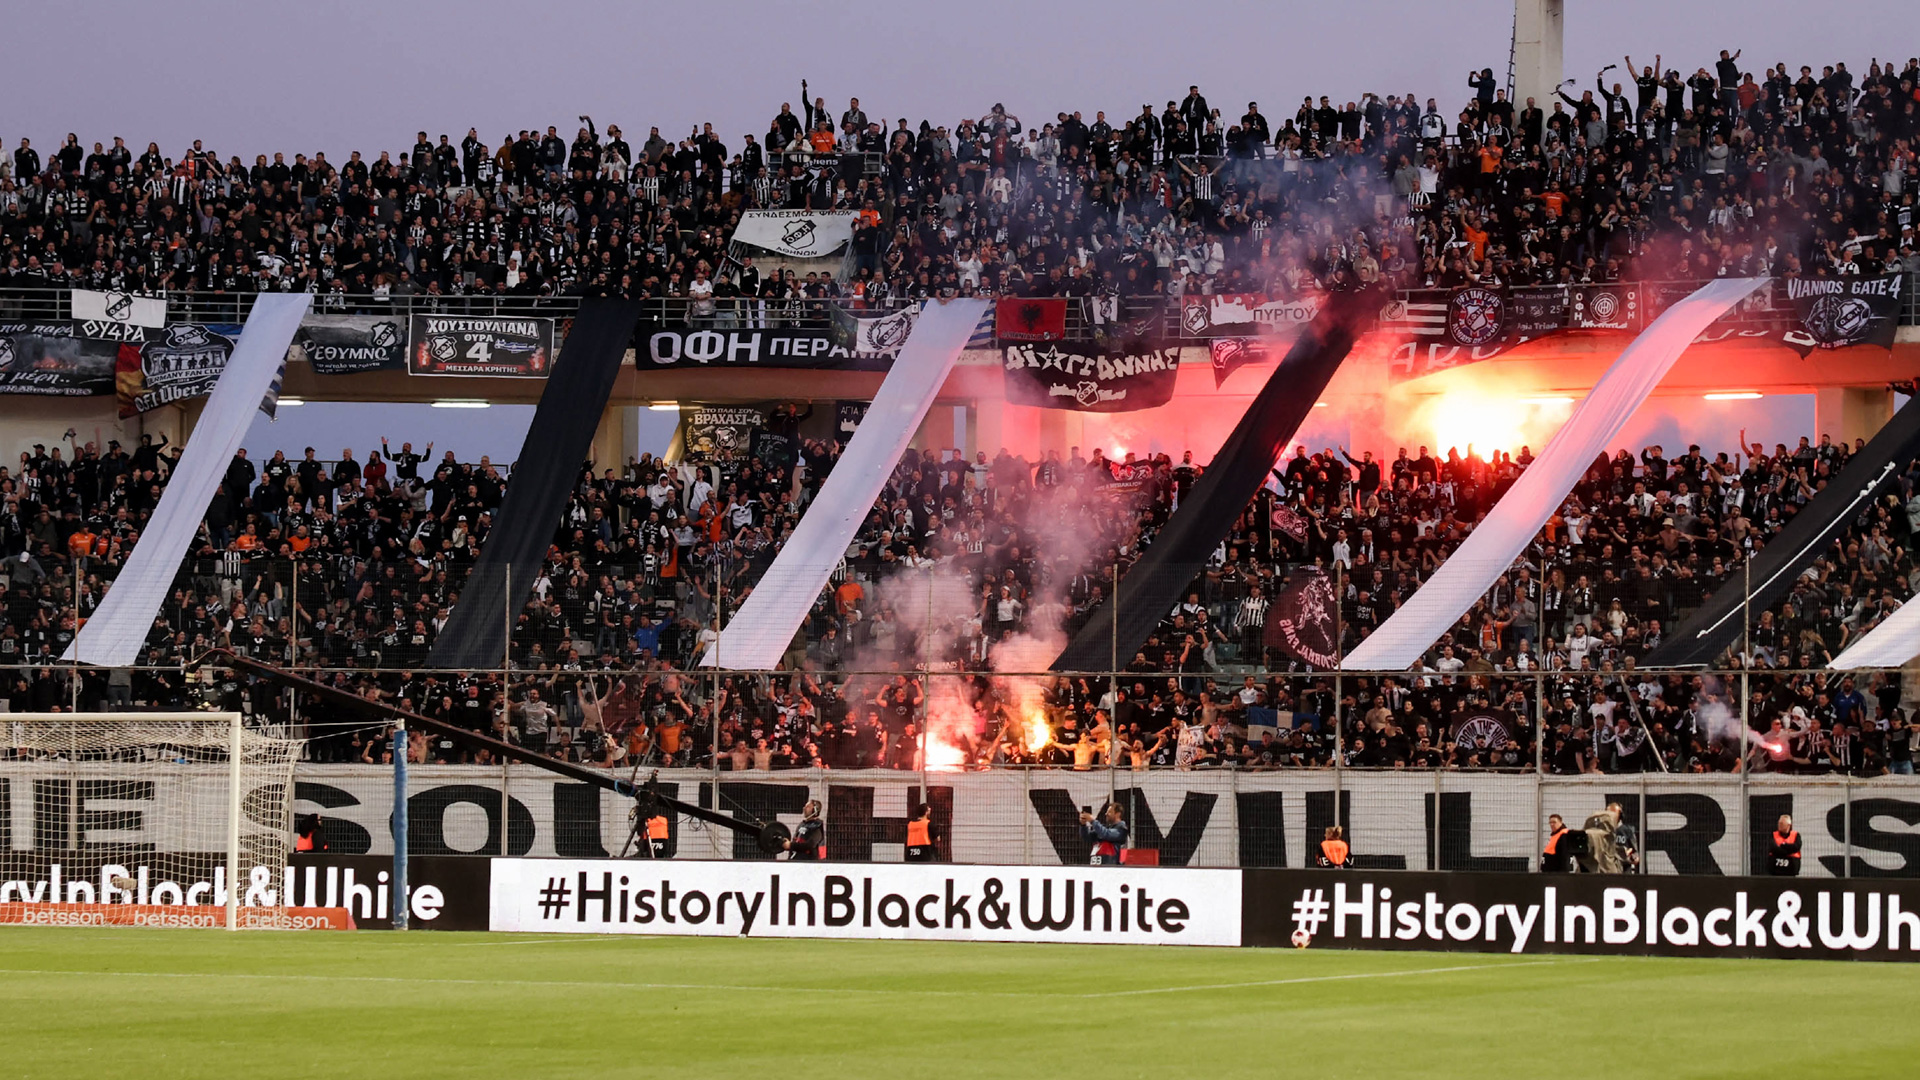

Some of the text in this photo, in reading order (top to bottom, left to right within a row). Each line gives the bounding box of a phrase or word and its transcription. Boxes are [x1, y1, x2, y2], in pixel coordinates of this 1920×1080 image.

[776, 247, 818, 256] ΑΘΗΝΩΝ
[1788, 274, 1902, 300] VIANNOS GATE 4
[428, 319, 538, 338] ΧΟΥΣΤΟΥΛΙΑΝΑ
[464, 334, 493, 343] ΘΥΡΑ
[650, 331, 761, 364] ΟΦΗ
[466, 342, 492, 363] 4
[185, 369, 203, 377] FAN
[446, 365, 483, 373] ΜΕΣΣΑΡΑ
[694, 414, 762, 426] ΒΡΑΧΑΣΙ-4
[1029, 787, 1530, 872] WILL
[538, 871, 1190, 937] #HistoryInBlack&White
[23, 907, 104, 924] betsson
[134, 910, 215, 928] betsson
[246, 910, 330, 930] betsson
[1291, 882, 1920, 954] #HistoryInBlack&Wh
